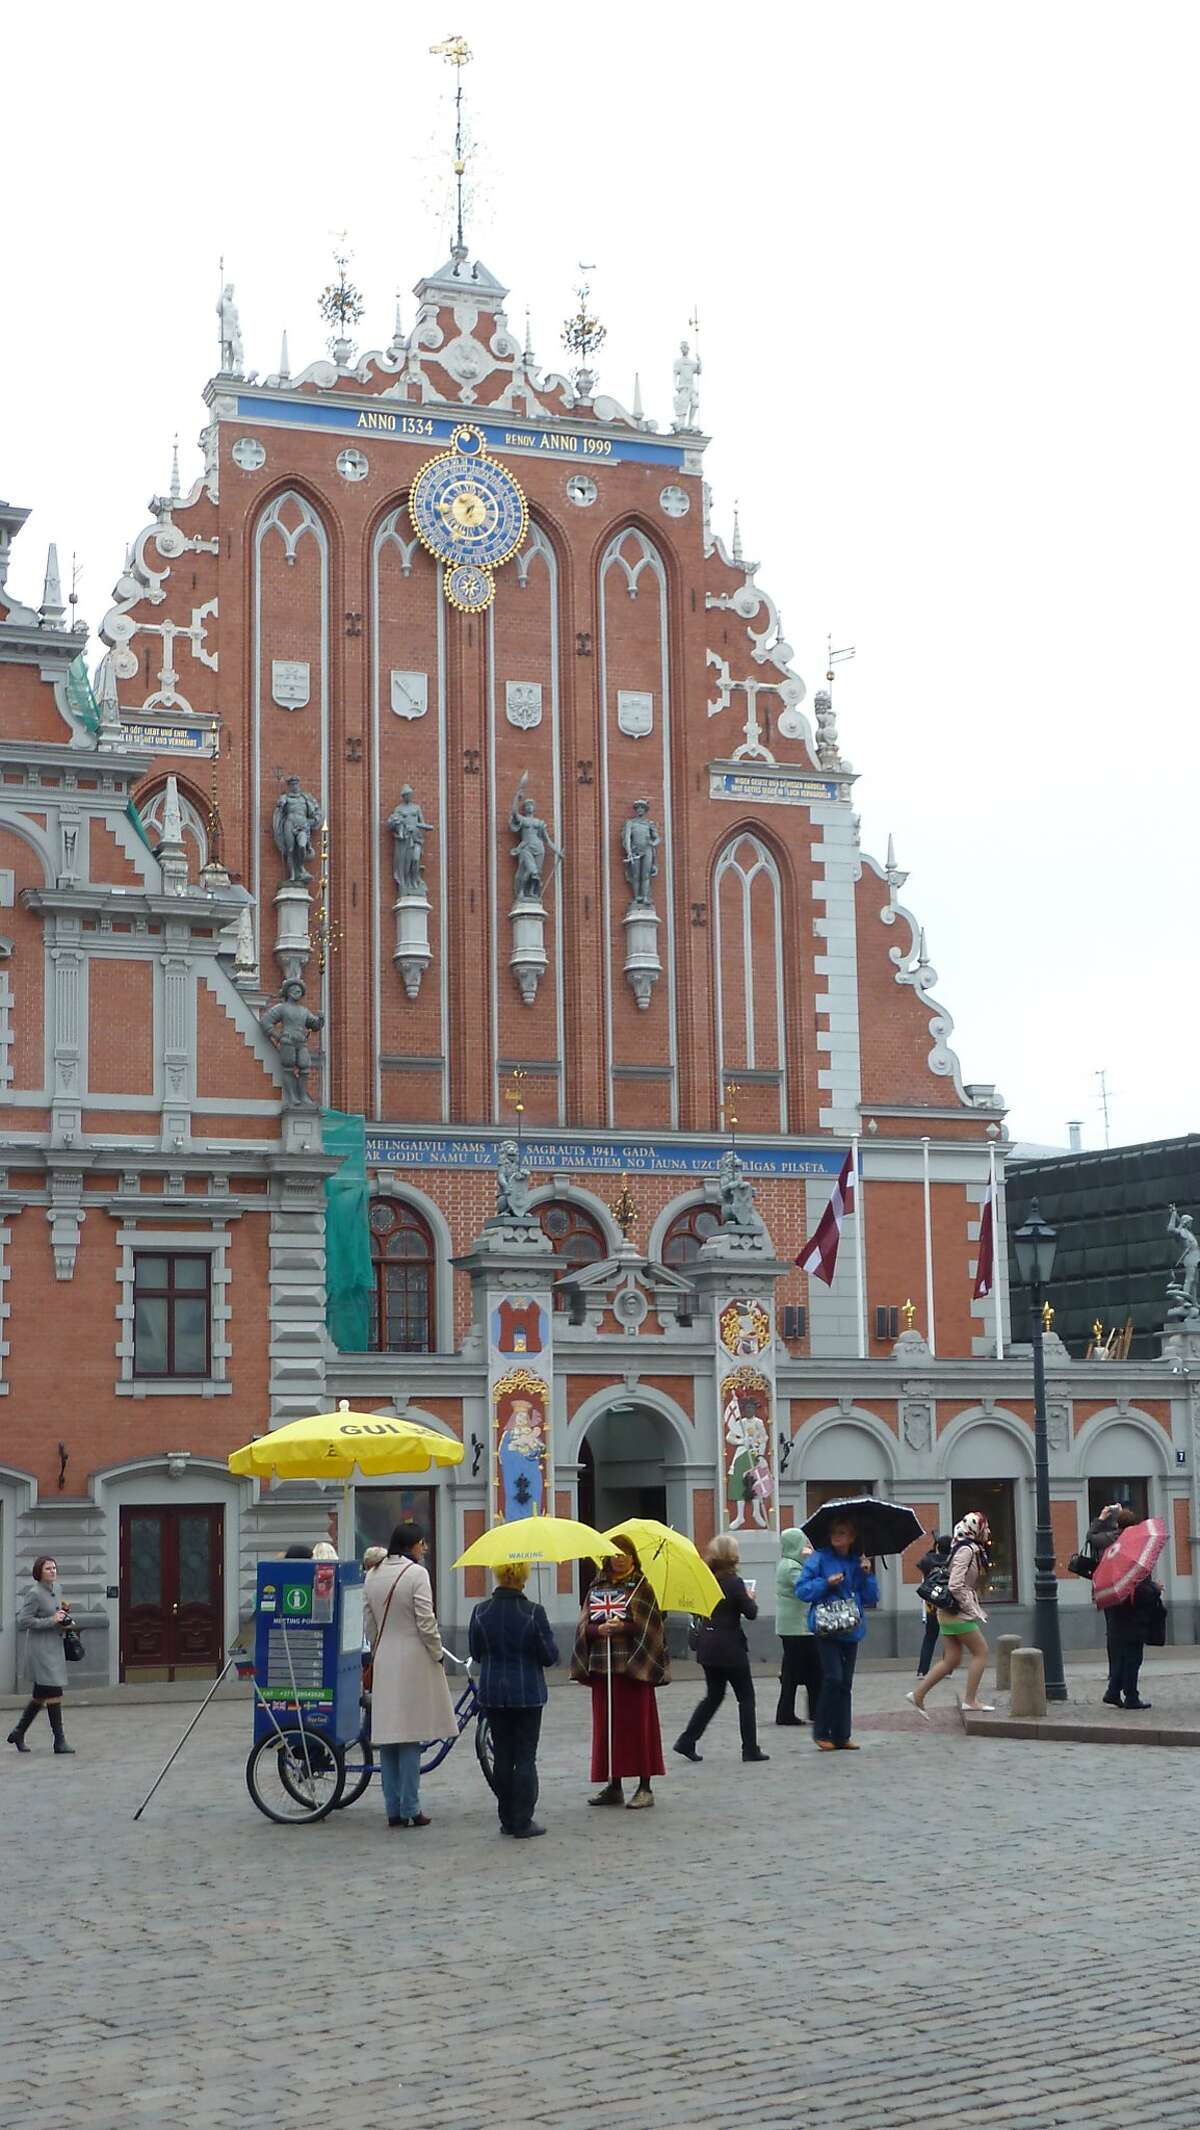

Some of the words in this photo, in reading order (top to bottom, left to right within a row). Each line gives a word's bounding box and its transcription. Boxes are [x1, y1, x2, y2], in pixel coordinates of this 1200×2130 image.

[357, 412, 396, 431] ANNO
[402, 418, 433, 435] 1334
[540, 437, 577, 452] ANNO
[583, 439, 612, 455] 1999
[452, 1142, 486, 1153] NAMS
[526, 1144, 585, 1156] SAGRAUTS
[365, 1151, 380, 1161] AR
[387, 1151, 423, 1162] GODU
[430, 1153, 467, 1163] NAMU
[474, 1154, 492, 1164] UZ
[561, 1156, 620, 1168] PAMATIEM
[627, 1159, 645, 1168] NO
[651, 1159, 687, 1170] JAUNA
